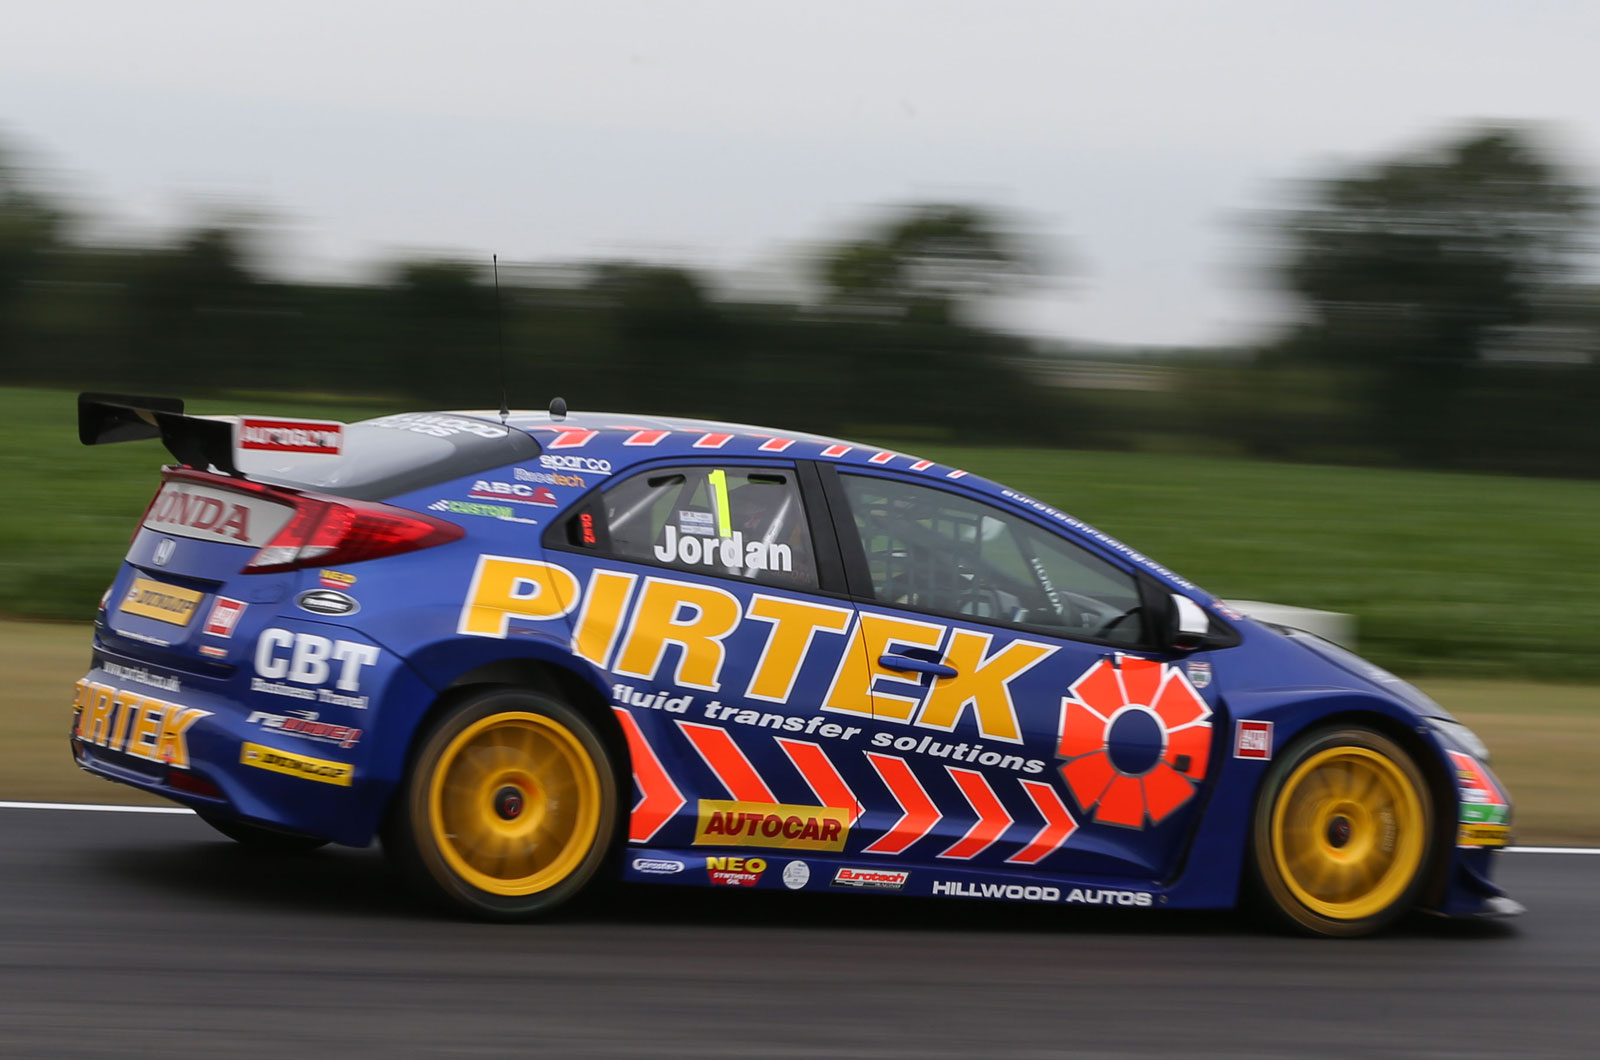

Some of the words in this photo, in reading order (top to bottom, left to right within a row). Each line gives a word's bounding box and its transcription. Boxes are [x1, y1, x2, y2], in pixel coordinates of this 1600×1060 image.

[540, 455, 611, 473] sparco
[472, 480, 535, 497] ABC
[707, 469, 733, 538] 1
[653, 525, 793, 572] Jordan
[254, 627, 381, 692] CBT
[456, 553, 1062, 746] PIRTEK
[612, 683, 694, 715] fluid
[704, 700, 861, 741] transfer
[871, 731, 1046, 774] solutions
[704, 811, 842, 842] AUTOCAR
[705, 856, 767, 873] NEO
[838, 869, 905, 883] Eurotech
[932, 880, 1060, 902] HILLWOOD
[1066, 888, 1153, 906] AUTOS
